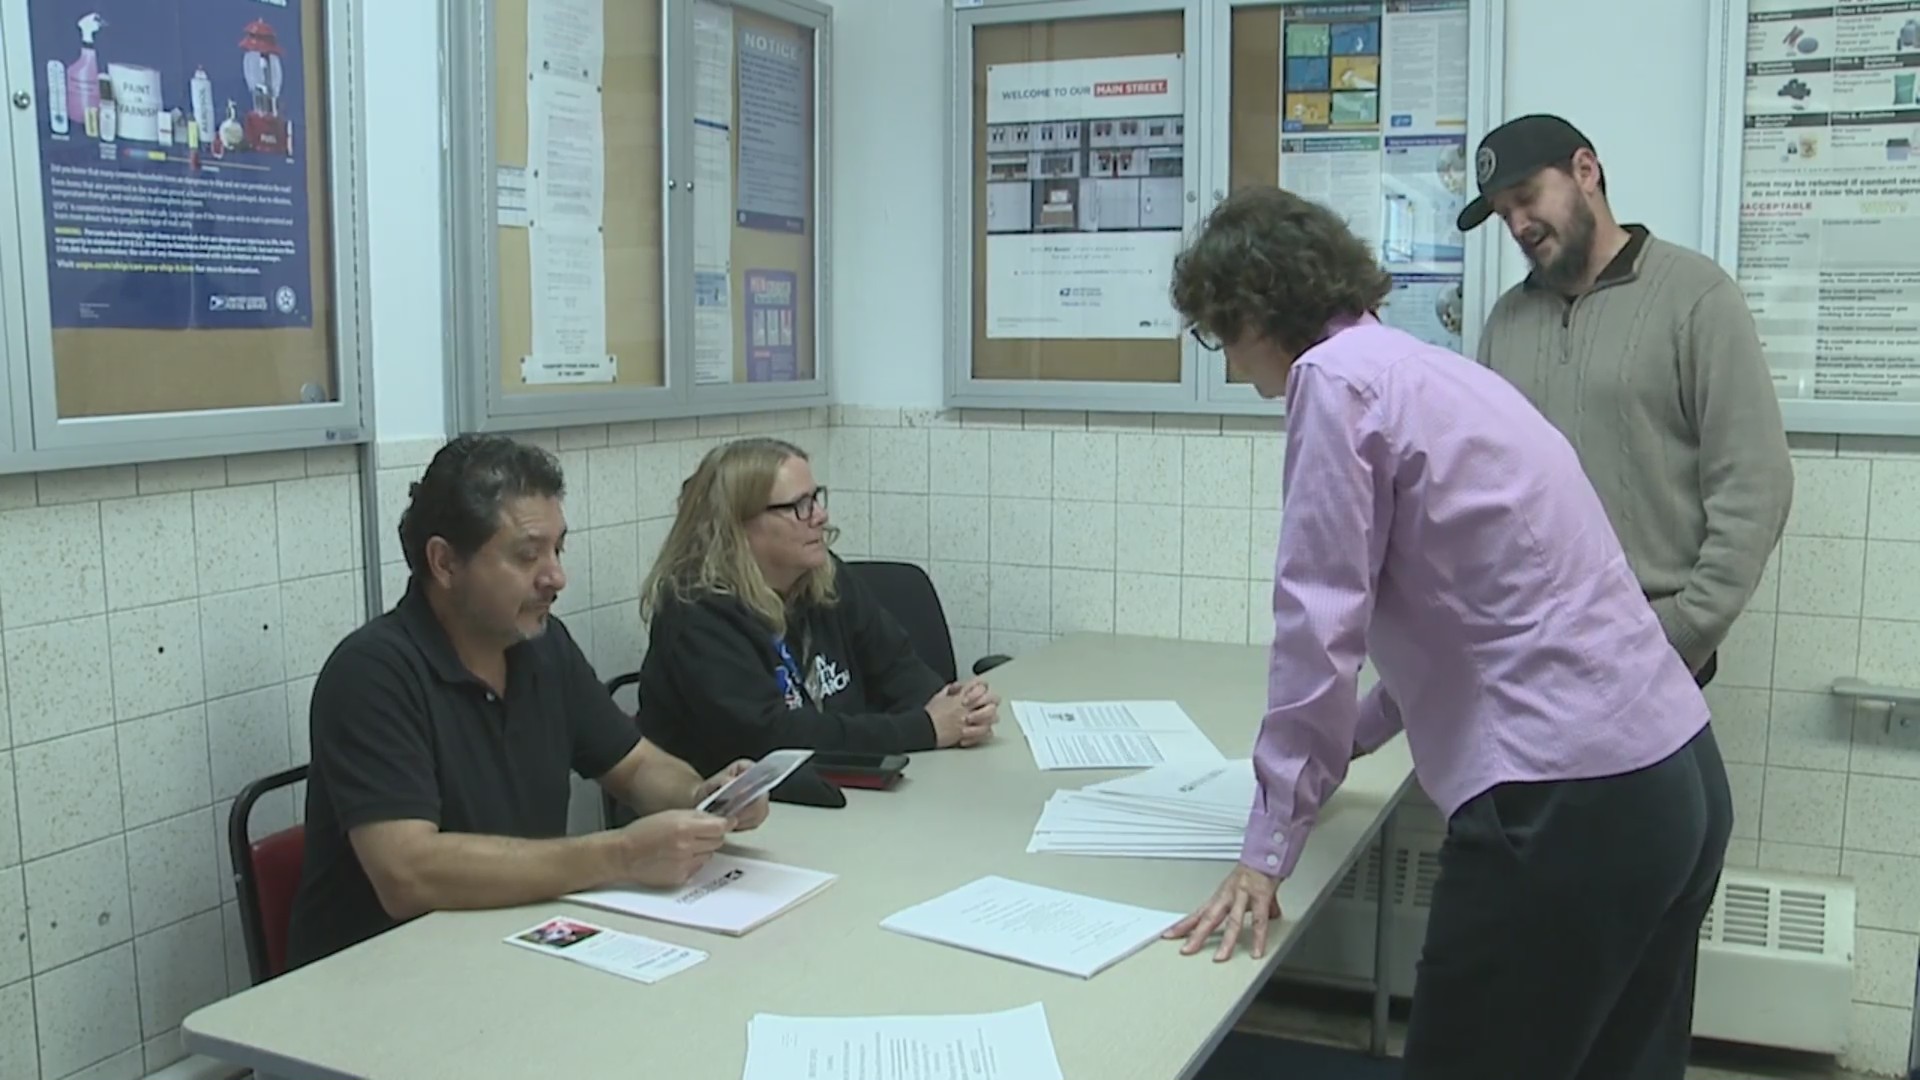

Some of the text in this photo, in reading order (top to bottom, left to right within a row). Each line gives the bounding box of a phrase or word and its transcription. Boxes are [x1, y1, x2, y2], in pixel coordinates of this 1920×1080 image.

[744, 32, 798, 60] NOTICE
[123, 82, 150, 95] PAINT
[1002, 88, 1050, 100] WELCOME
[1054, 87, 1067, 97] TO
[1070, 85, 1091, 96] OUR
[1096, 84, 1123, 95] MAIN
[260, 133, 277, 144] FUEL
[1773, 181, 1792, 189] may
[1795, 179, 1806, 187] be
[1808, 178, 1848, 187] returned
[1860, 177, 1897, 186] content
[1751, 188, 1763, 197] do
[1765, 189, 1781, 197] not
[1783, 187, 1807, 197] make
[1810, 187, 1817, 196] it
[1819, 187, 1842, 196] clear
[1845, 186, 1864, 195] that
[1866, 187, 1879, 195] no
